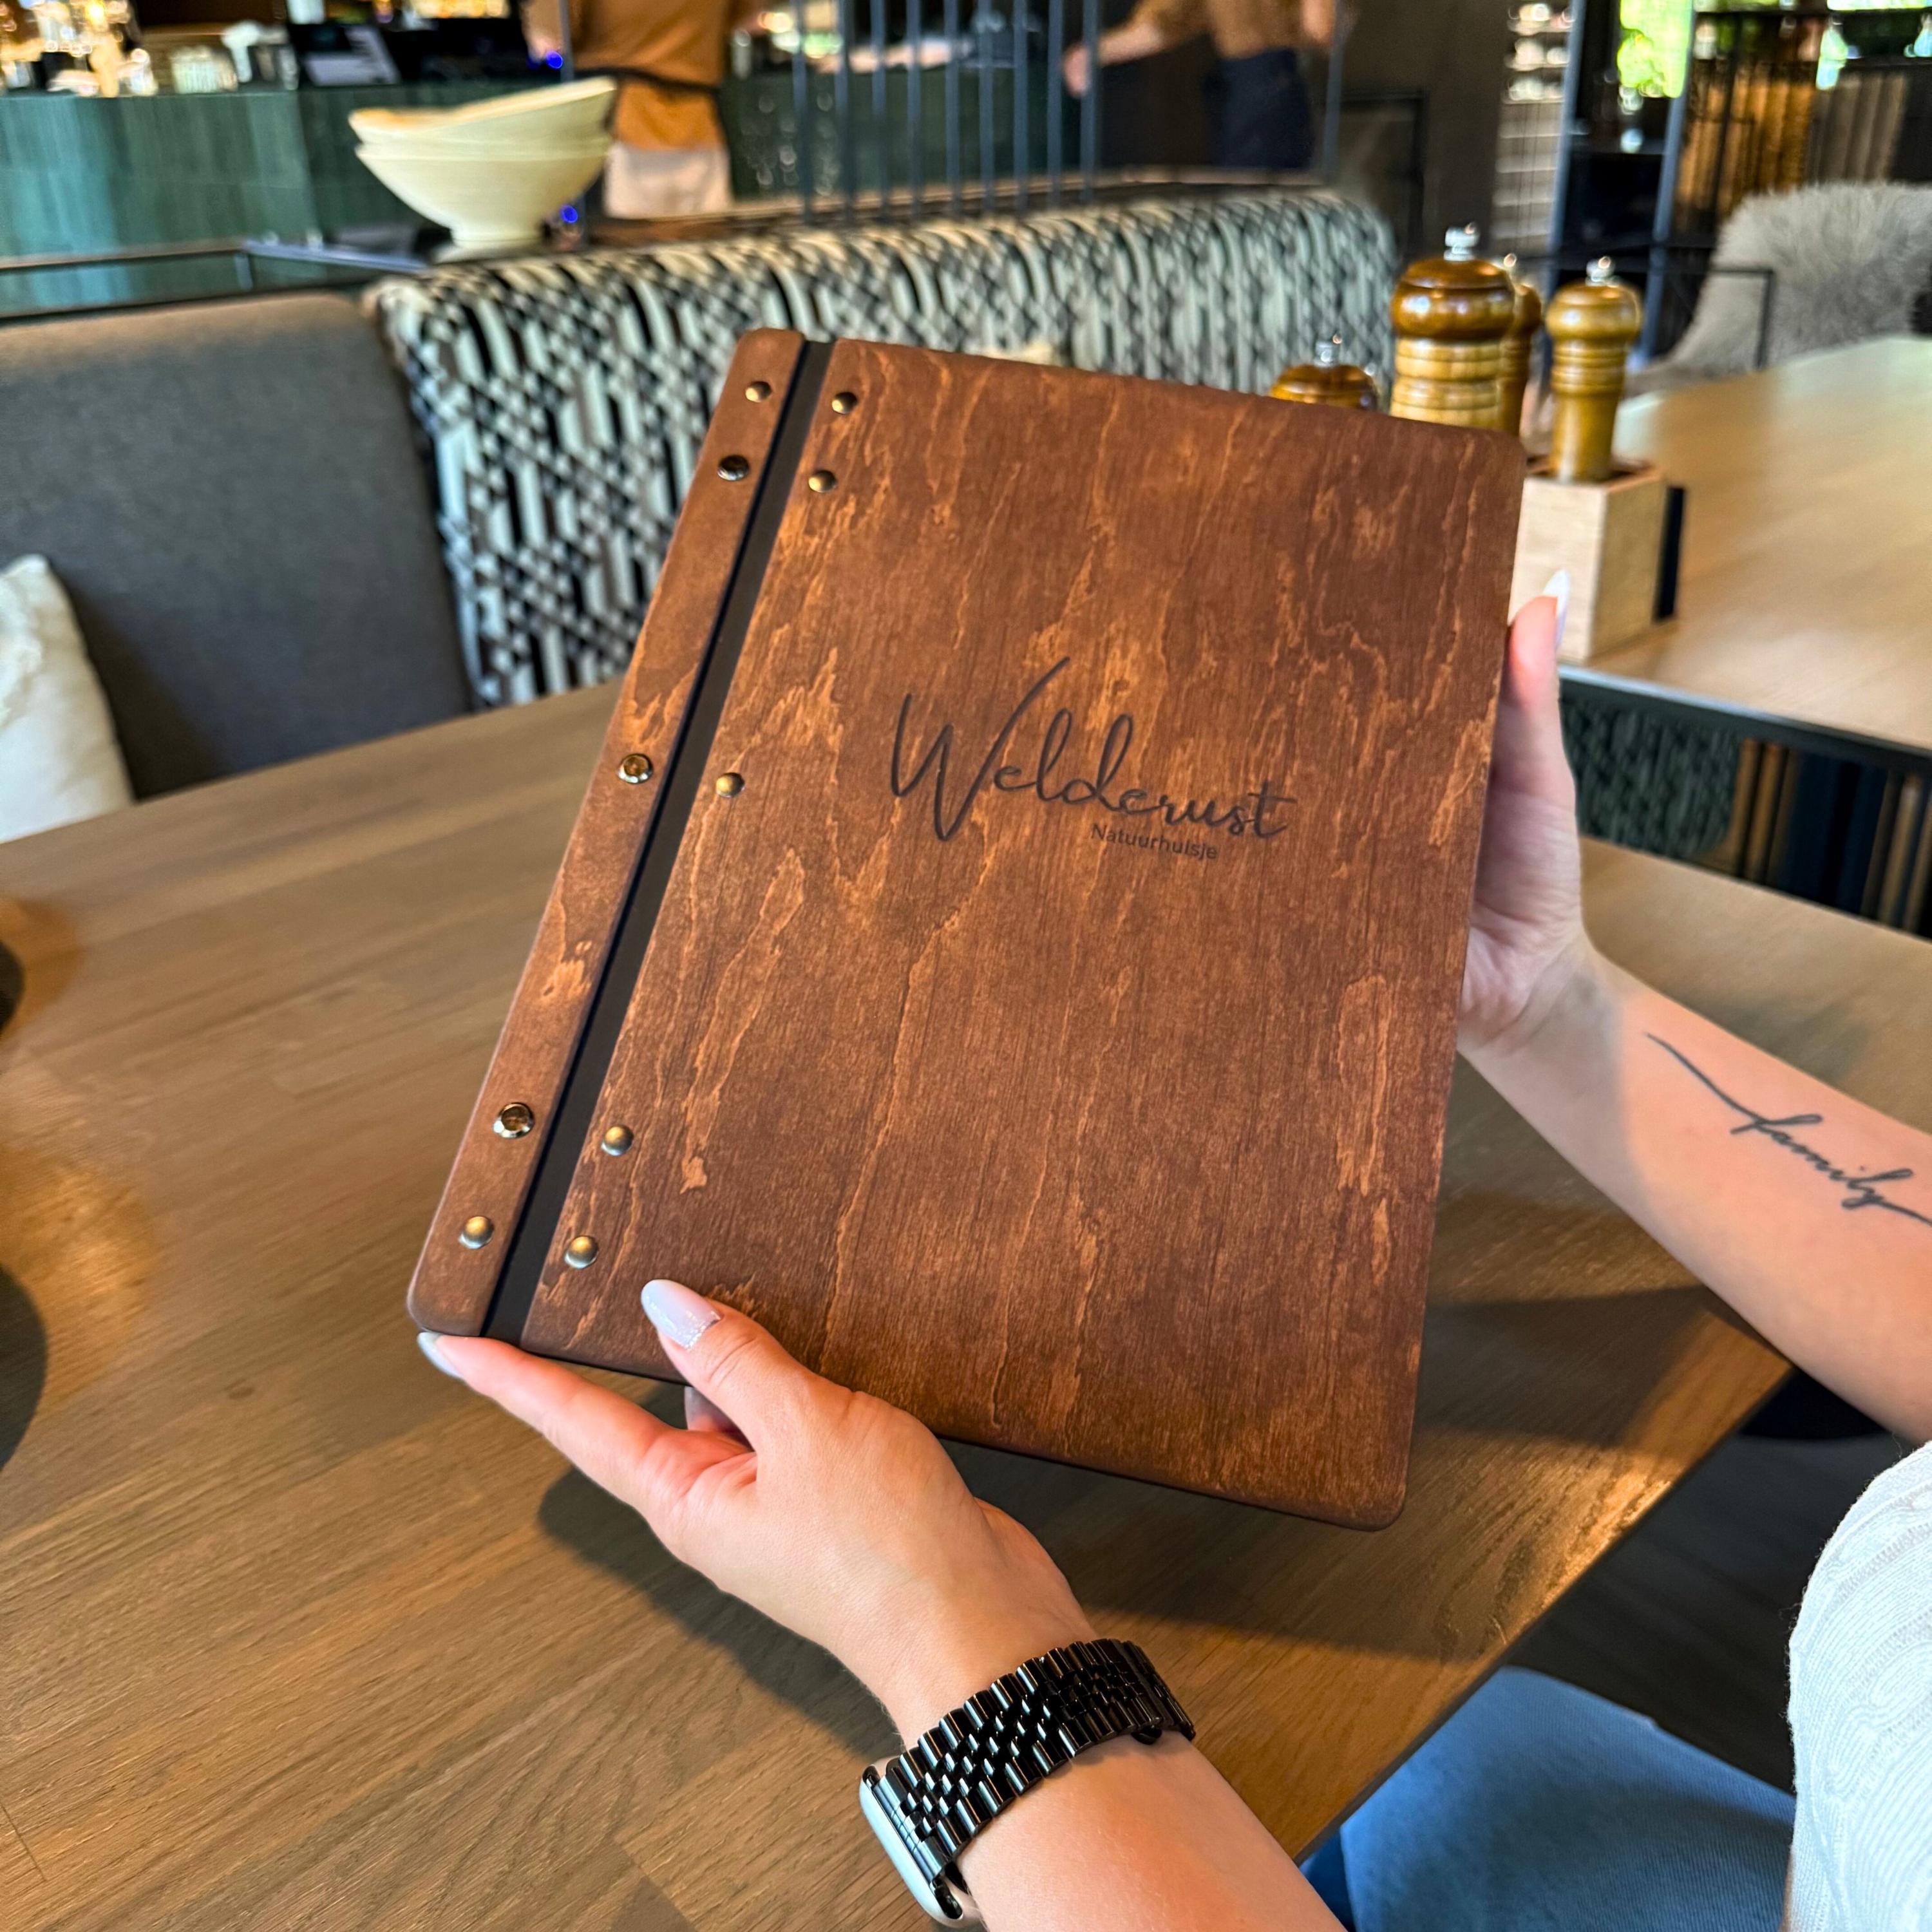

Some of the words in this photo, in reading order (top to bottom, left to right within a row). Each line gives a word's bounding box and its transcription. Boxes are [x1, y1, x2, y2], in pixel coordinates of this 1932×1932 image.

[890, 656, 1298, 842] Welderust
[1091, 824, 1218, 860] Natuurhuisje
[1645, 1032, 1932, 1226] family
